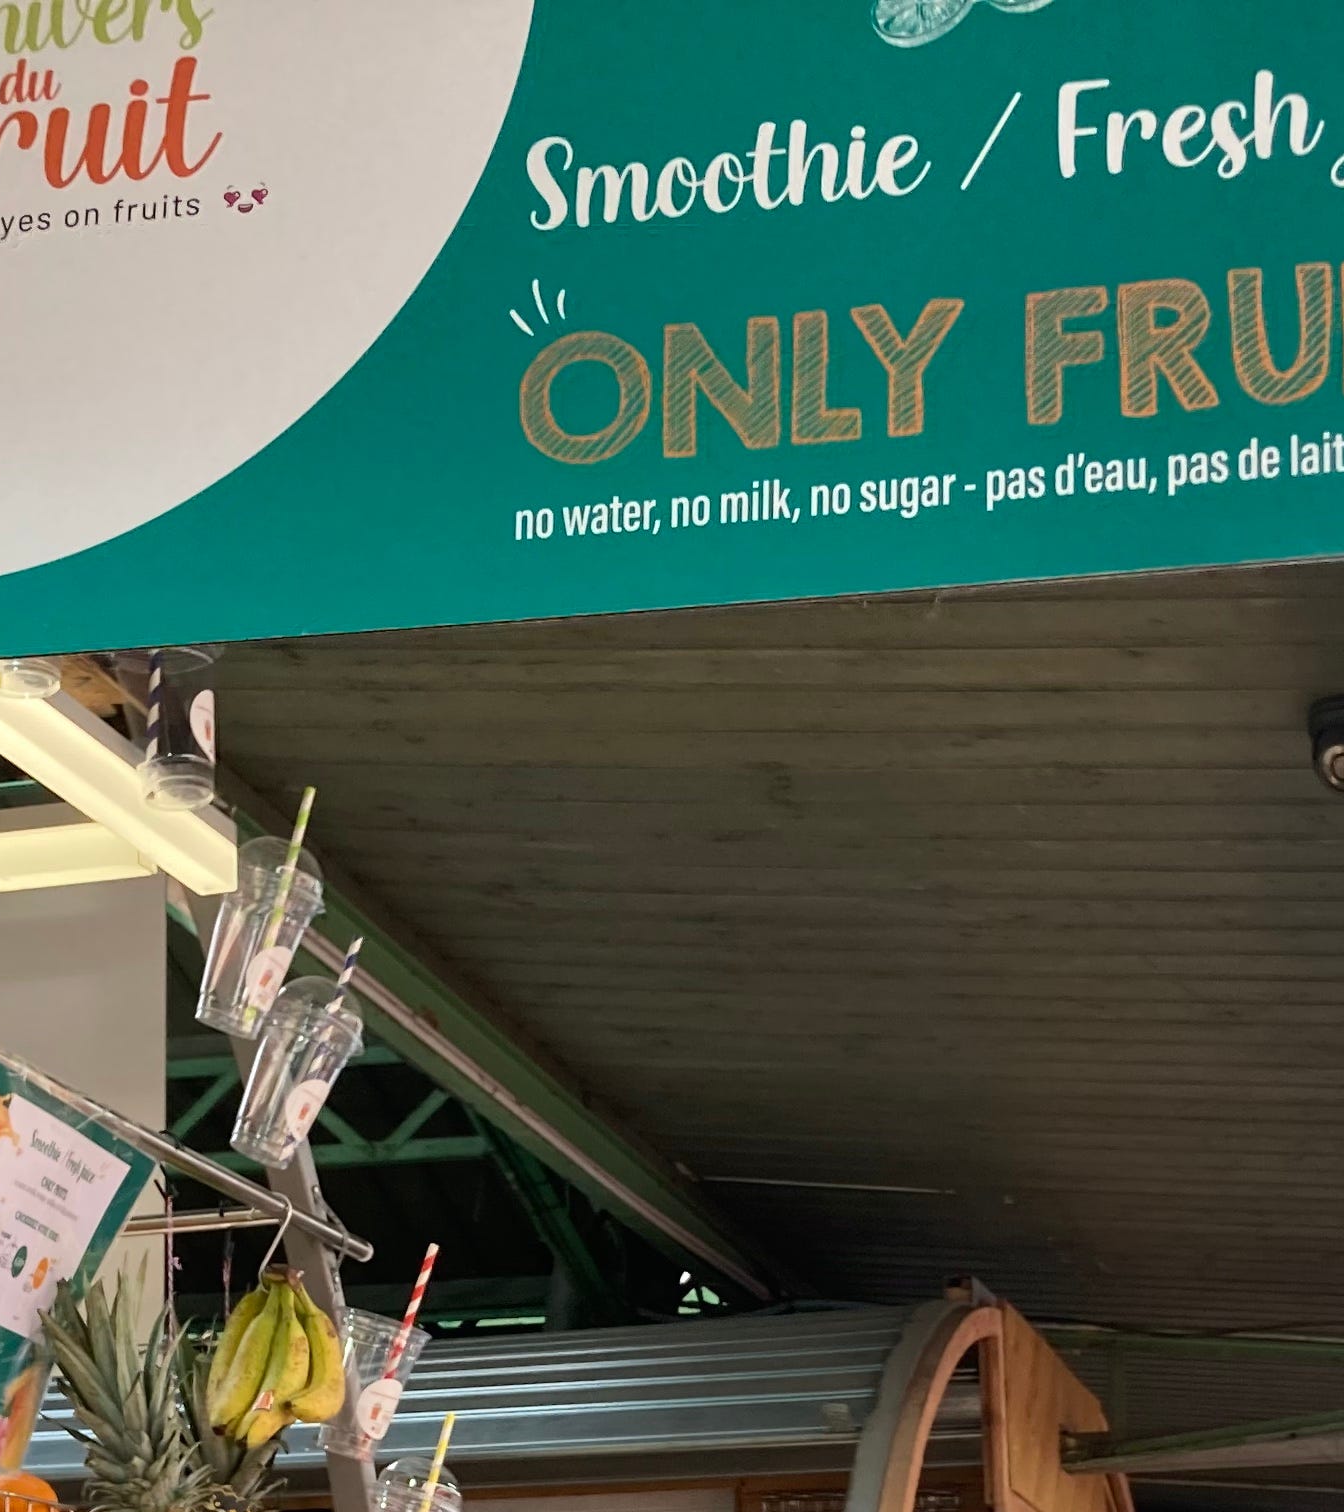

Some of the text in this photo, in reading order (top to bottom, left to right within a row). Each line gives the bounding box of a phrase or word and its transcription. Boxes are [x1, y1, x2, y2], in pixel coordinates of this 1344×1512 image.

[0, 58, 62, 106] du
[527, 119, 932, 233] Smoothie
[1055, 69, 1324, 181] Fresh
[64, 207, 99, 228] on
[113, 194, 201, 224] fruits
[519, 297, 964, 465] ONLY
[514, 508, 554, 540] no
[562, 495, 660, 535] water,
[670, 494, 710, 529] no
[720, 479, 800, 524] milk,
[810, 483, 850, 517] no
[859, 473, 956, 520] sugar
[986, 465, 1046, 511] pas
[1055, 453, 1157, 497] d'eau,
[1167, 450, 1229, 496] pas
[1238, 437, 1280, 481] de
